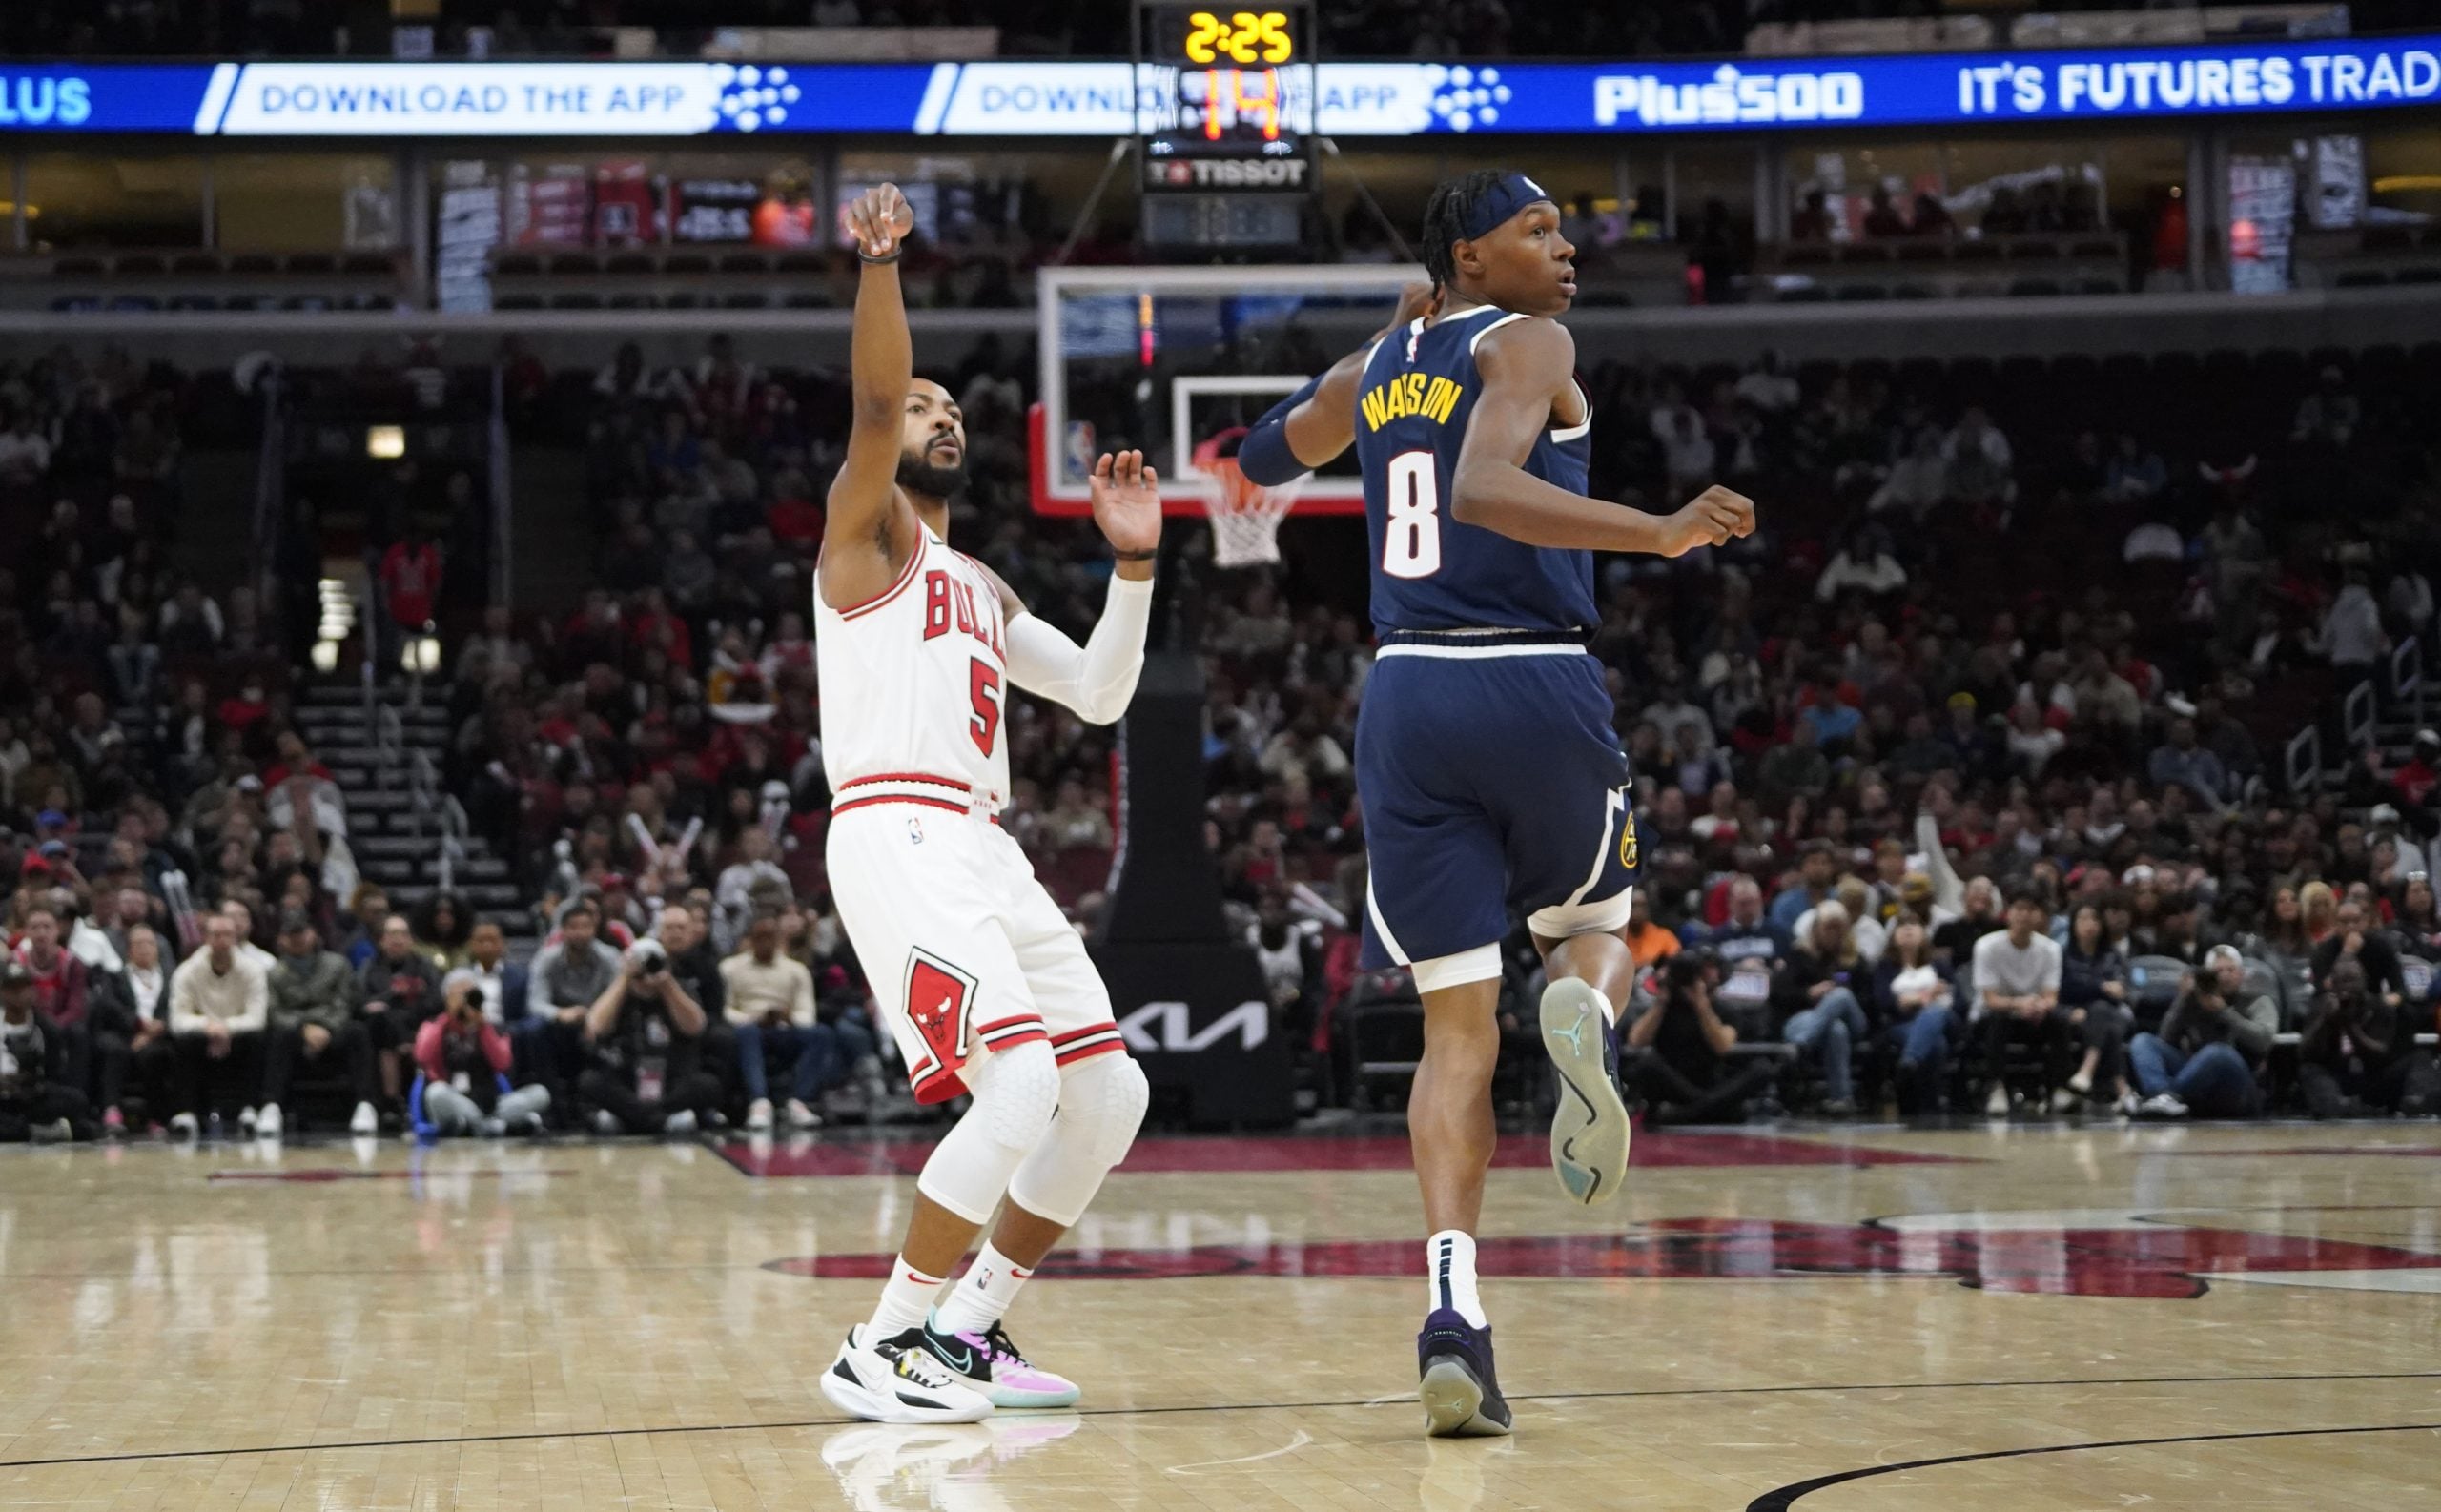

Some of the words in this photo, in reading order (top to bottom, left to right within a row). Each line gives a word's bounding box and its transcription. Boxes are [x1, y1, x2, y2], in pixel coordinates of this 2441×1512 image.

[1186, 12, 1291, 63] 2:25
[261, 85, 507, 112] DOWNLOAD
[522, 85, 596, 112] THE
[606, 85, 685, 112] APP
[981, 85, 1165, 113] DOWNLO
[1323, 85, 1398, 113] APP
[1205, 69, 1280, 140] 14
[1593, 63, 1864, 126] Plus500
[1959, 61, 2046, 113] IT'S
[2058, 57, 2295, 111] FUTURES
[2300, 51, 2440, 102] TRAD
[1192, 159, 1307, 185] TISSOT
[1383, 449, 1441, 580] 8
[923, 569, 1007, 668] BULL
[969, 654, 1000, 759] 5
